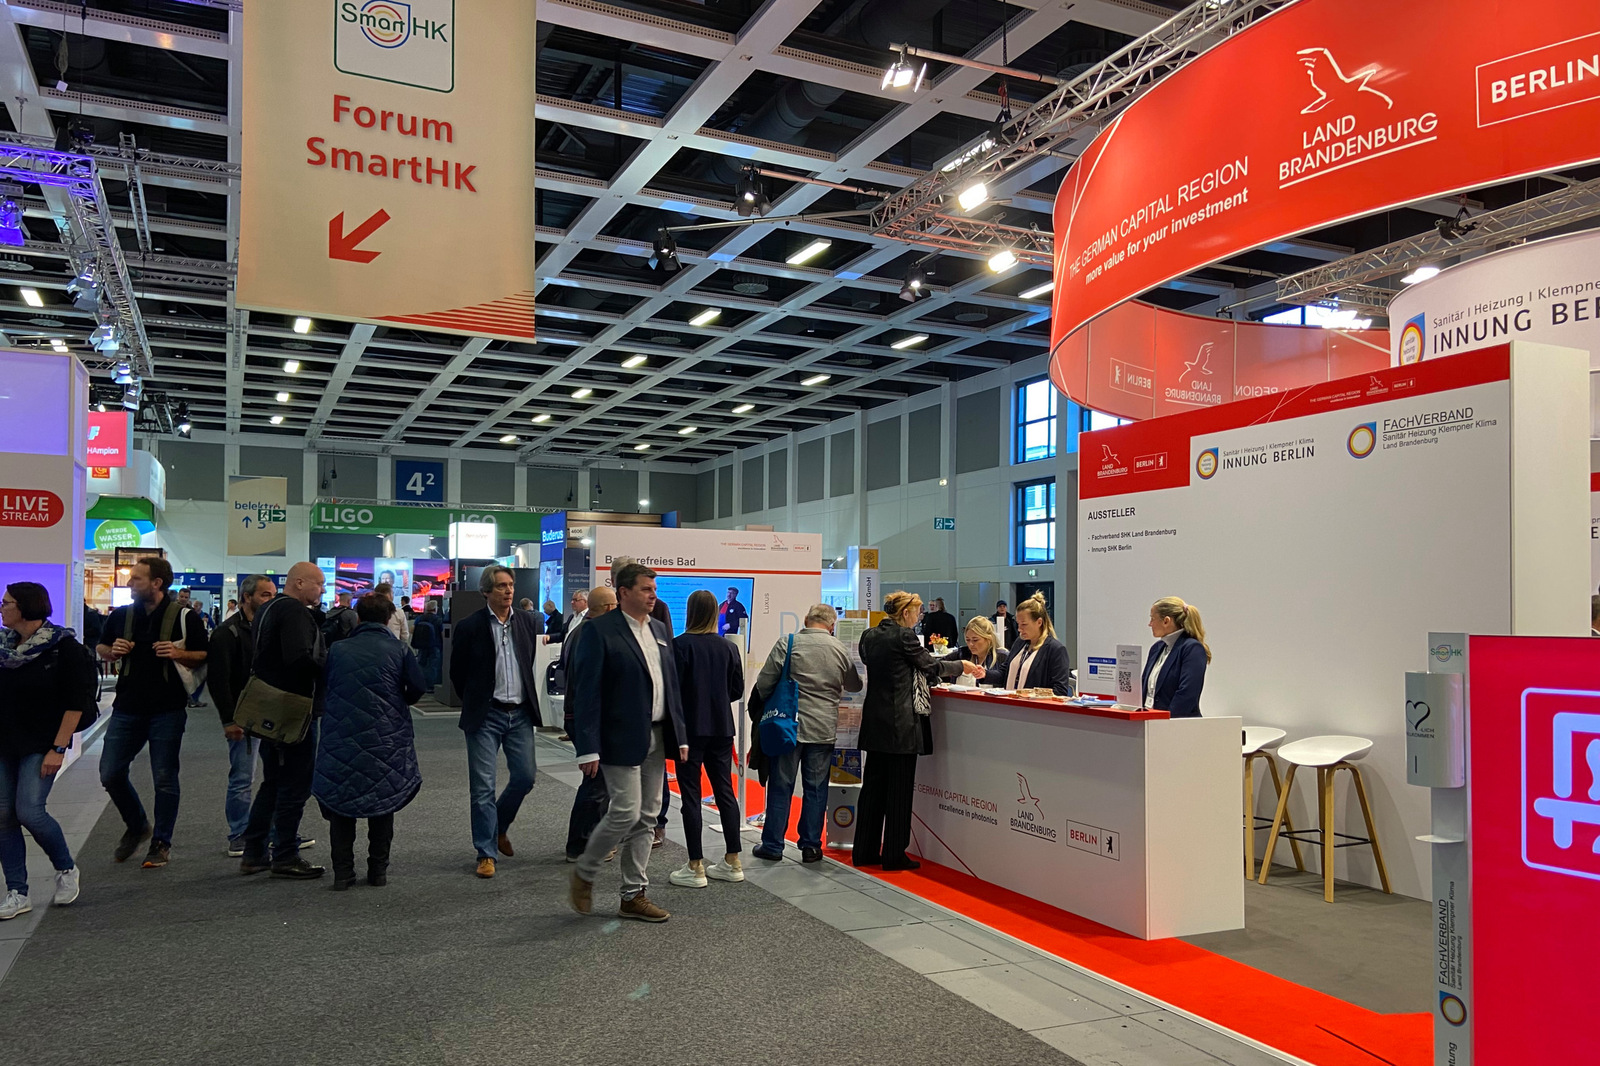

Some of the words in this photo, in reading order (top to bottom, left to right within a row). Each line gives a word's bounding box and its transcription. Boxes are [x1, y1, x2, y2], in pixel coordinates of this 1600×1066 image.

[1491, 54, 1600, 104] BERLIN
[333, 94, 453, 143] Forum
[1303, 114, 1356, 149] LAND
[1279, 112, 1438, 181] BRANDENBURG
[306, 136, 477, 193] SmartHK
[1069, 262, 1081, 281] THE
[1081, 225, 1118, 267] GERMAN
[1120, 194, 1173, 237] CAPITAL
[1178, 156, 1248, 206] REGION
[1085, 264, 1102, 285] more
[1104, 249, 1125, 271] value
[1127, 239, 1141, 257] for
[1142, 226, 1168, 252] your
[1171, 186, 1248, 234] investment
[1433, 310, 1464, 329] Sanitär
[1474, 295, 1524, 315] Heizung
[1433, 309, 1532, 354] INNUNG
[1383, 407, 1474, 431] FACHVERBAND
[1383, 432, 1406, 441] Sanitär
[1408, 427, 1436, 438] Heizung
[1438, 423, 1474, 433] Klempner
[1475, 419, 1497, 428] Klima
[1399, 437, 1438, 447] Brandenburg
[1136, 459, 1154, 468] BERLIN
[1223, 453, 1267, 469] INNUNG
[1273, 446, 1315, 462] BERLIN
[3, 495, 49, 511] LIVE
[1088, 507, 1135, 520] AUSSTELLER
[2, 512, 49, 521] STREAM
[321, 507, 373, 524] LIGO
[542, 530, 564, 542] Buderus
[1092, 533, 1120, 541] Fachverband
[677, 557, 696, 566] Bad
[917, 783, 943, 798] GERMAN
[944, 791, 970, 805] CAPITAL
[971, 797, 997, 813] REGION
[939, 803, 964, 815] excellence
[971, 812, 998, 825] photonics
[1017, 809, 1034, 821] LAND
[1010, 817, 1056, 839] BRANDENBURG
[1070, 829, 1097, 845] BERLIN
[1439, 899, 1448, 985] FACHVERBAND
